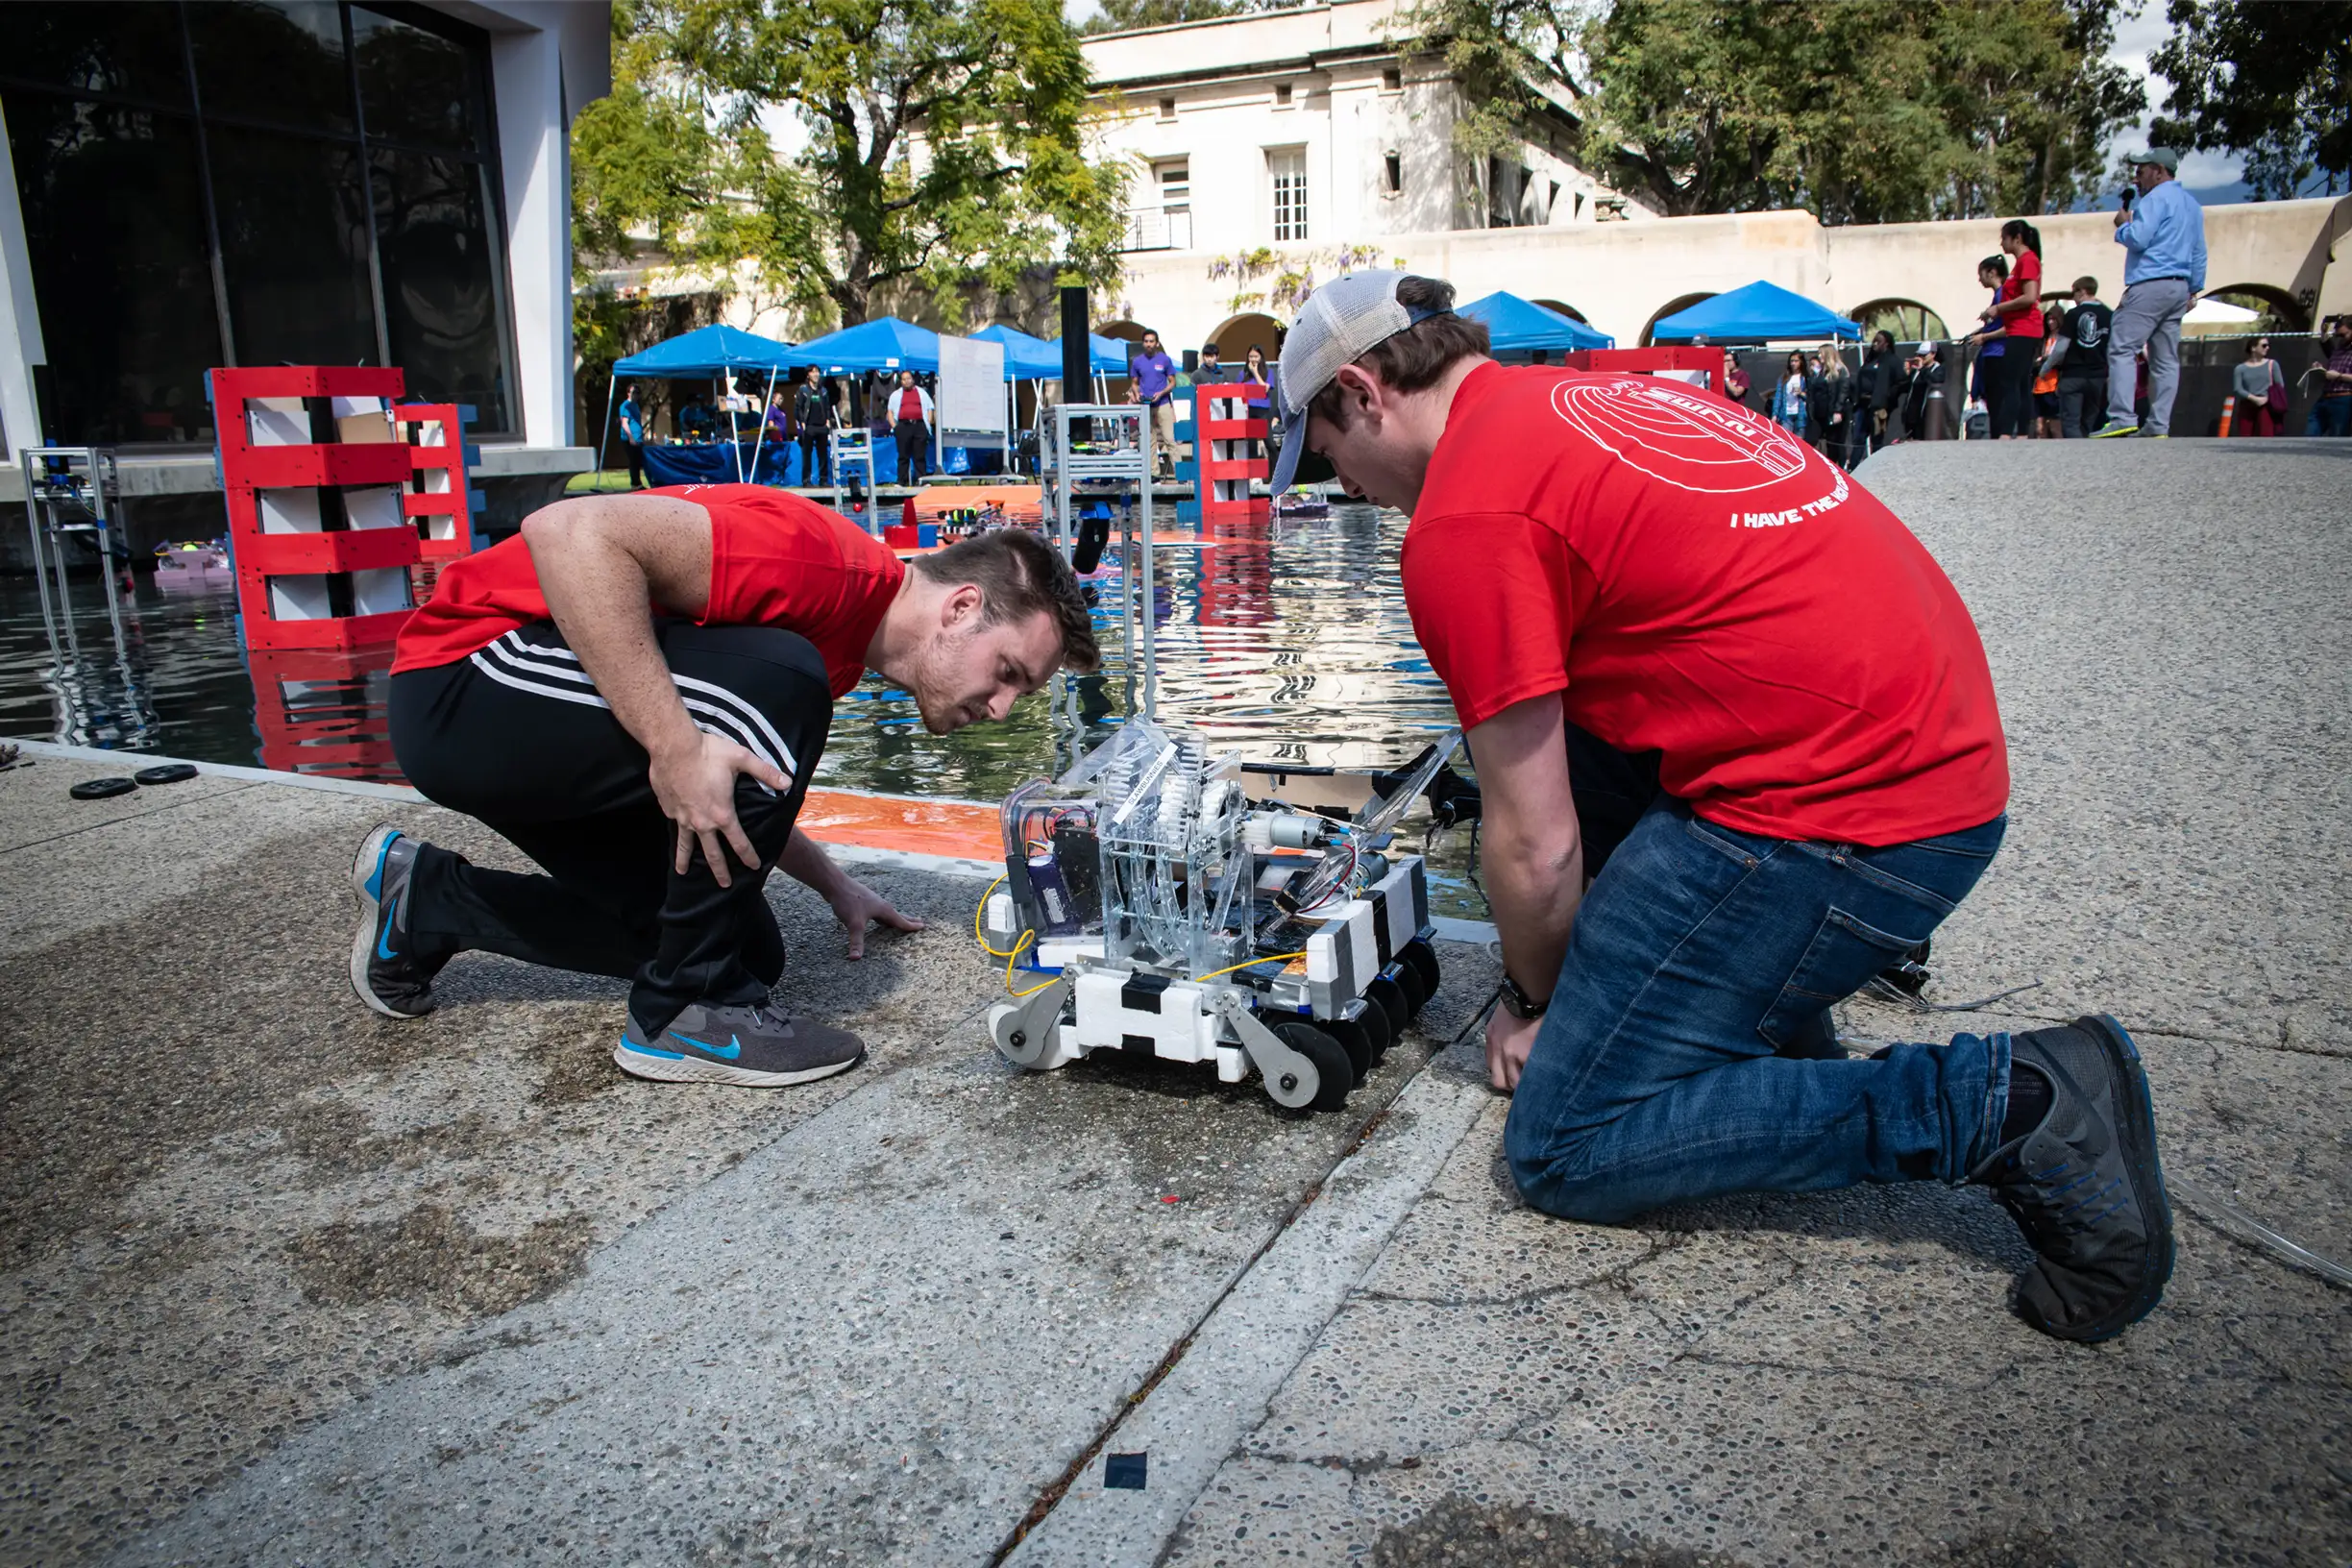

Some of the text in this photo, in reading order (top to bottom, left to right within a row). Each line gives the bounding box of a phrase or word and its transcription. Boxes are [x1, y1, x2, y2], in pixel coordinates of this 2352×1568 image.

[1729, 513, 1738, 528] I
[1744, 508, 1803, 528] HAVE
[1801, 496, 1840, 517] THE
